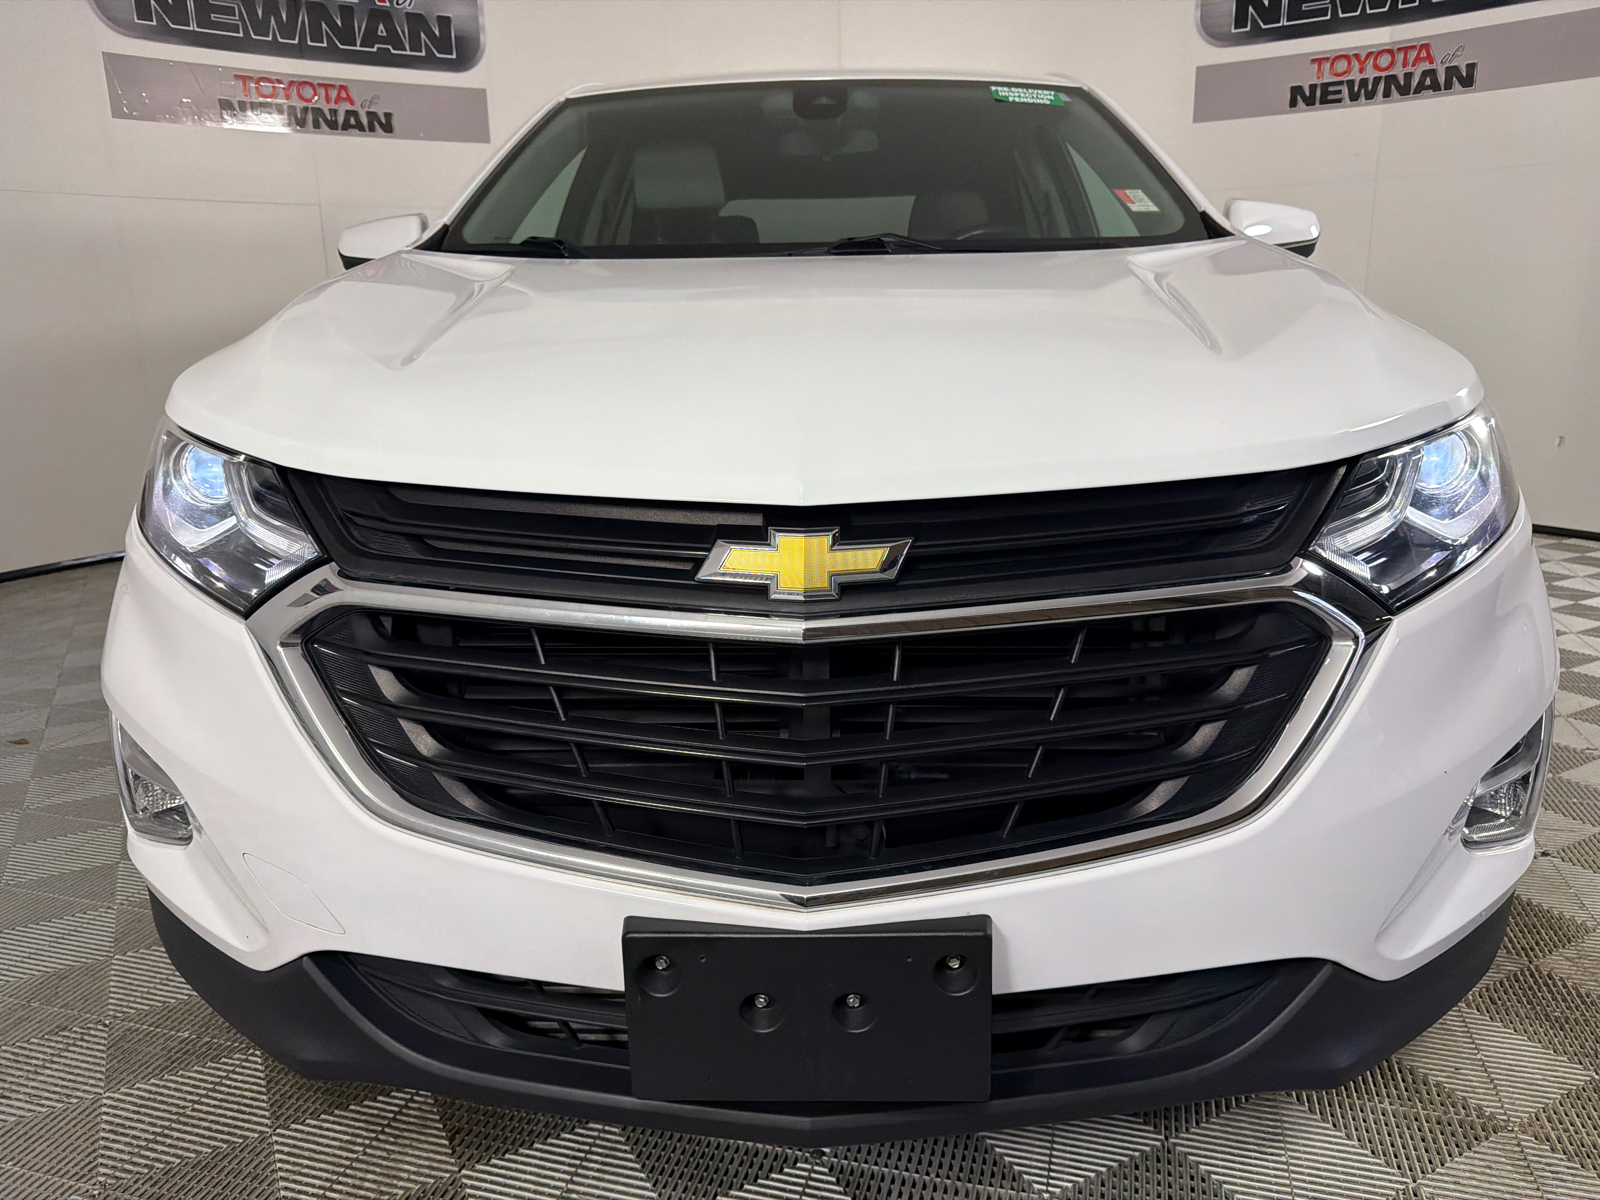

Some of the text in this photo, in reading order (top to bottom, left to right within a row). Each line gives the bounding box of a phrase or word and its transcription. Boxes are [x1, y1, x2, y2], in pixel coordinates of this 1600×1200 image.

[1310, 42, 1465, 80] TOYOTA of
[233, 74, 380, 110] TOYOTA of
[990, 86, 1055, 96] PRE-DELIVERY
[998, 91, 1055, 100] INSPECTION
[1289, 62, 1477, 109] NEWNAN
[1008, 96, 1051, 104] PENDING
